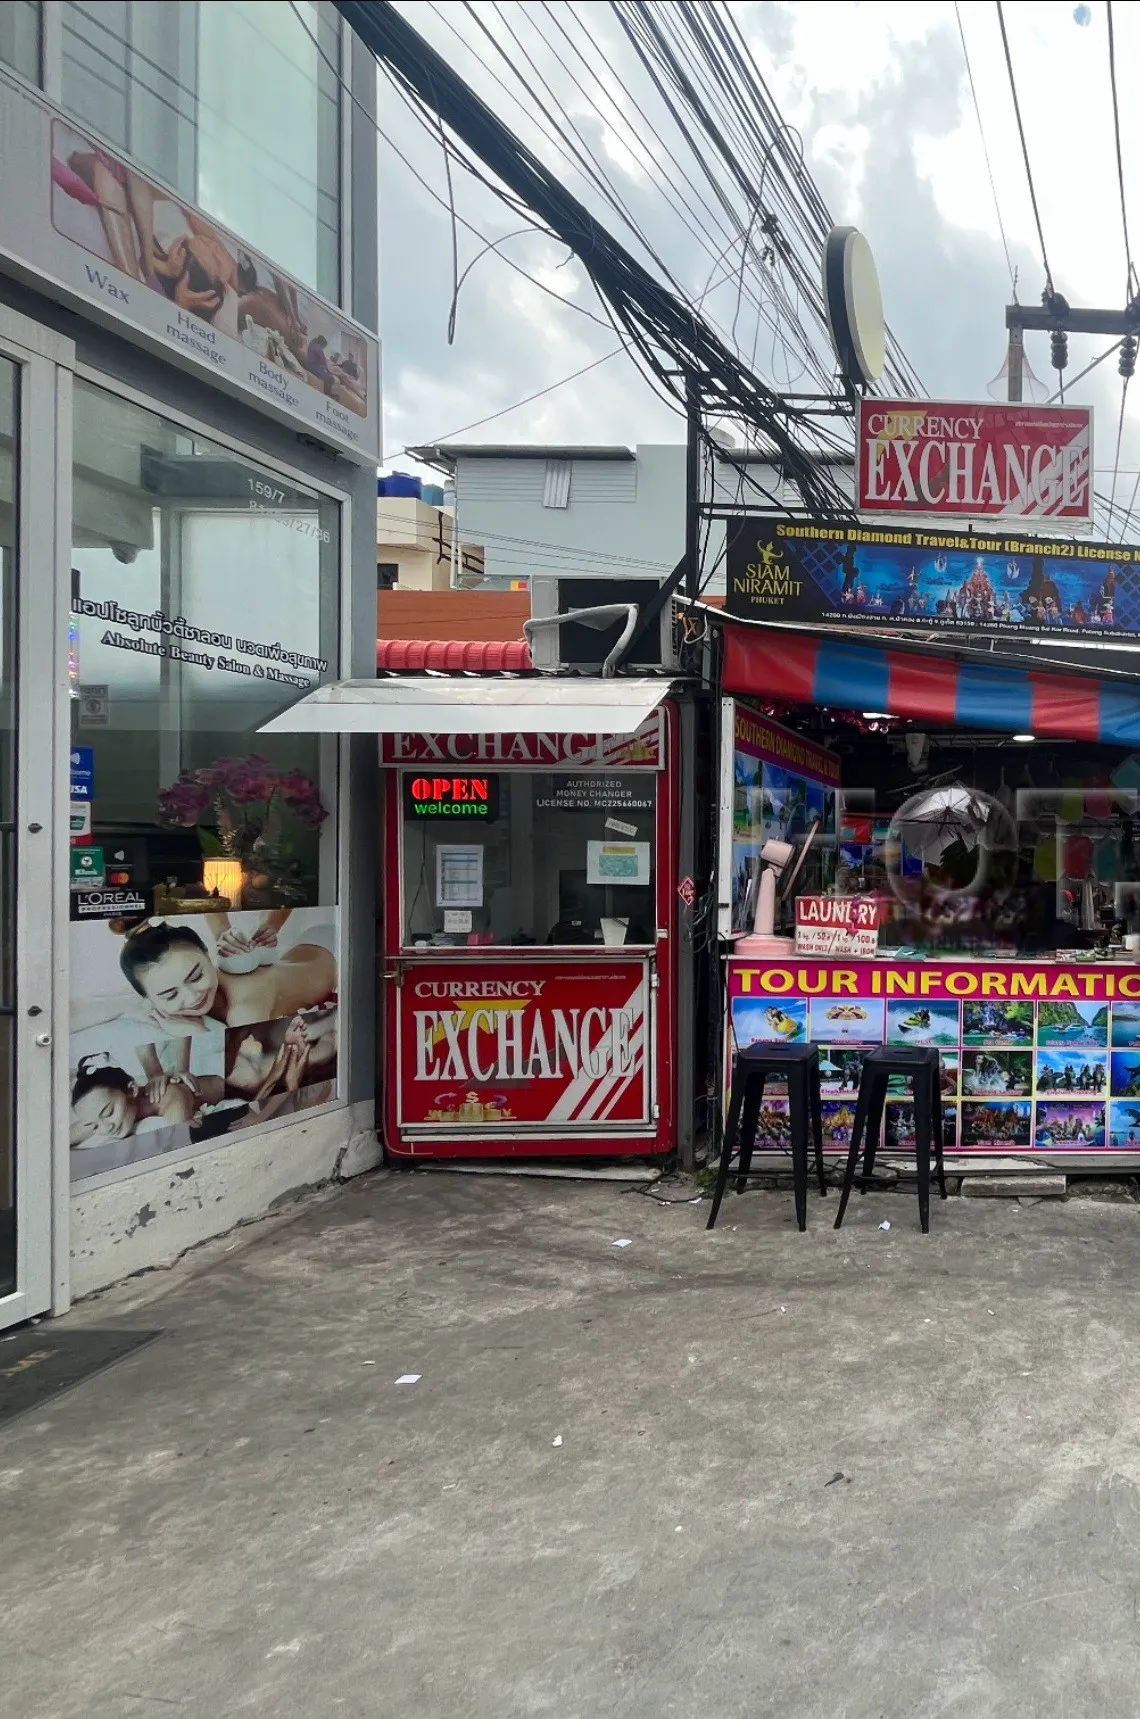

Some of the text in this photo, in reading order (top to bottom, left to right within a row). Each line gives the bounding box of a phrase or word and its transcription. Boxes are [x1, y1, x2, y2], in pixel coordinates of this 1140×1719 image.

[84, 264, 130, 304] Wax
[177, 311, 216, 345] Head
[166, 324, 227, 366] massage
[259, 360, 290, 390] Body
[249, 371, 300, 408] massage
[326, 400, 350, 424] Foot
[315, 411, 360, 442] massage
[868, 414, 984, 440] CURRENCY
[865, 438, 1085, 508] EXCHANGE
[248, 479, 285, 504] 159/7
[776, 524, 844, 540] Southern
[848, 529, 912, 545] Diamond
[1078, 545, 1131, 562] License
[746, 563, 790, 580] SIAM
[733, 578, 803, 597] NIRAMIT
[750, 596, 785, 605] PHUKET
[101, 630, 310, 689] Absolute Beauty Salon & Massage
[391, 733, 616, 761] EXCHANGE
[735, 715, 776, 754] SOUTHERN
[70, 785, 87, 794] ISA
[411, 778, 490, 800] OPEN
[556, 789, 632, 798] MONEY CHANGER
[566, 780, 622, 789] AUTHORIZED
[415, 801, 489, 815] welcome
[537, 799, 574, 807] LICENSE
[414, 980, 546, 998] CURRENCY
[733, 968, 859, 994] TOUR
[413, 1007, 637, 1082] EXCHANGE
